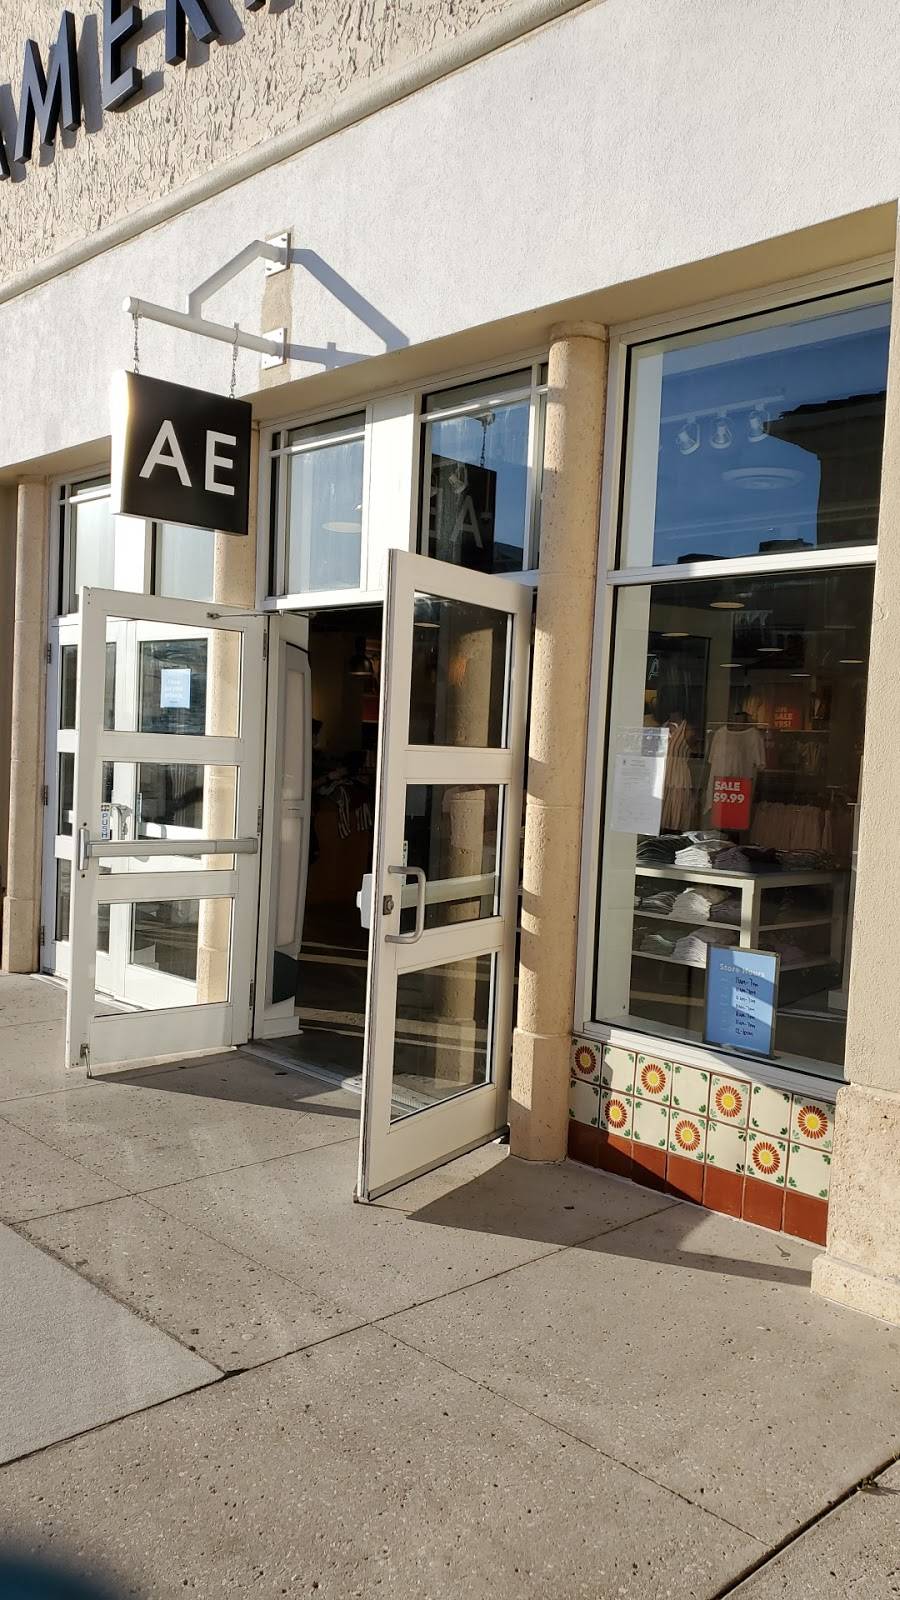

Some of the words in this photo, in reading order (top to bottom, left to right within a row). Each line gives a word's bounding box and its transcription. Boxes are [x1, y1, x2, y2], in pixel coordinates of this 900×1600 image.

[138, 419, 238, 496] AE
[714, 780, 741, 792] SALE
[713, 793, 745, 804] $9.99
